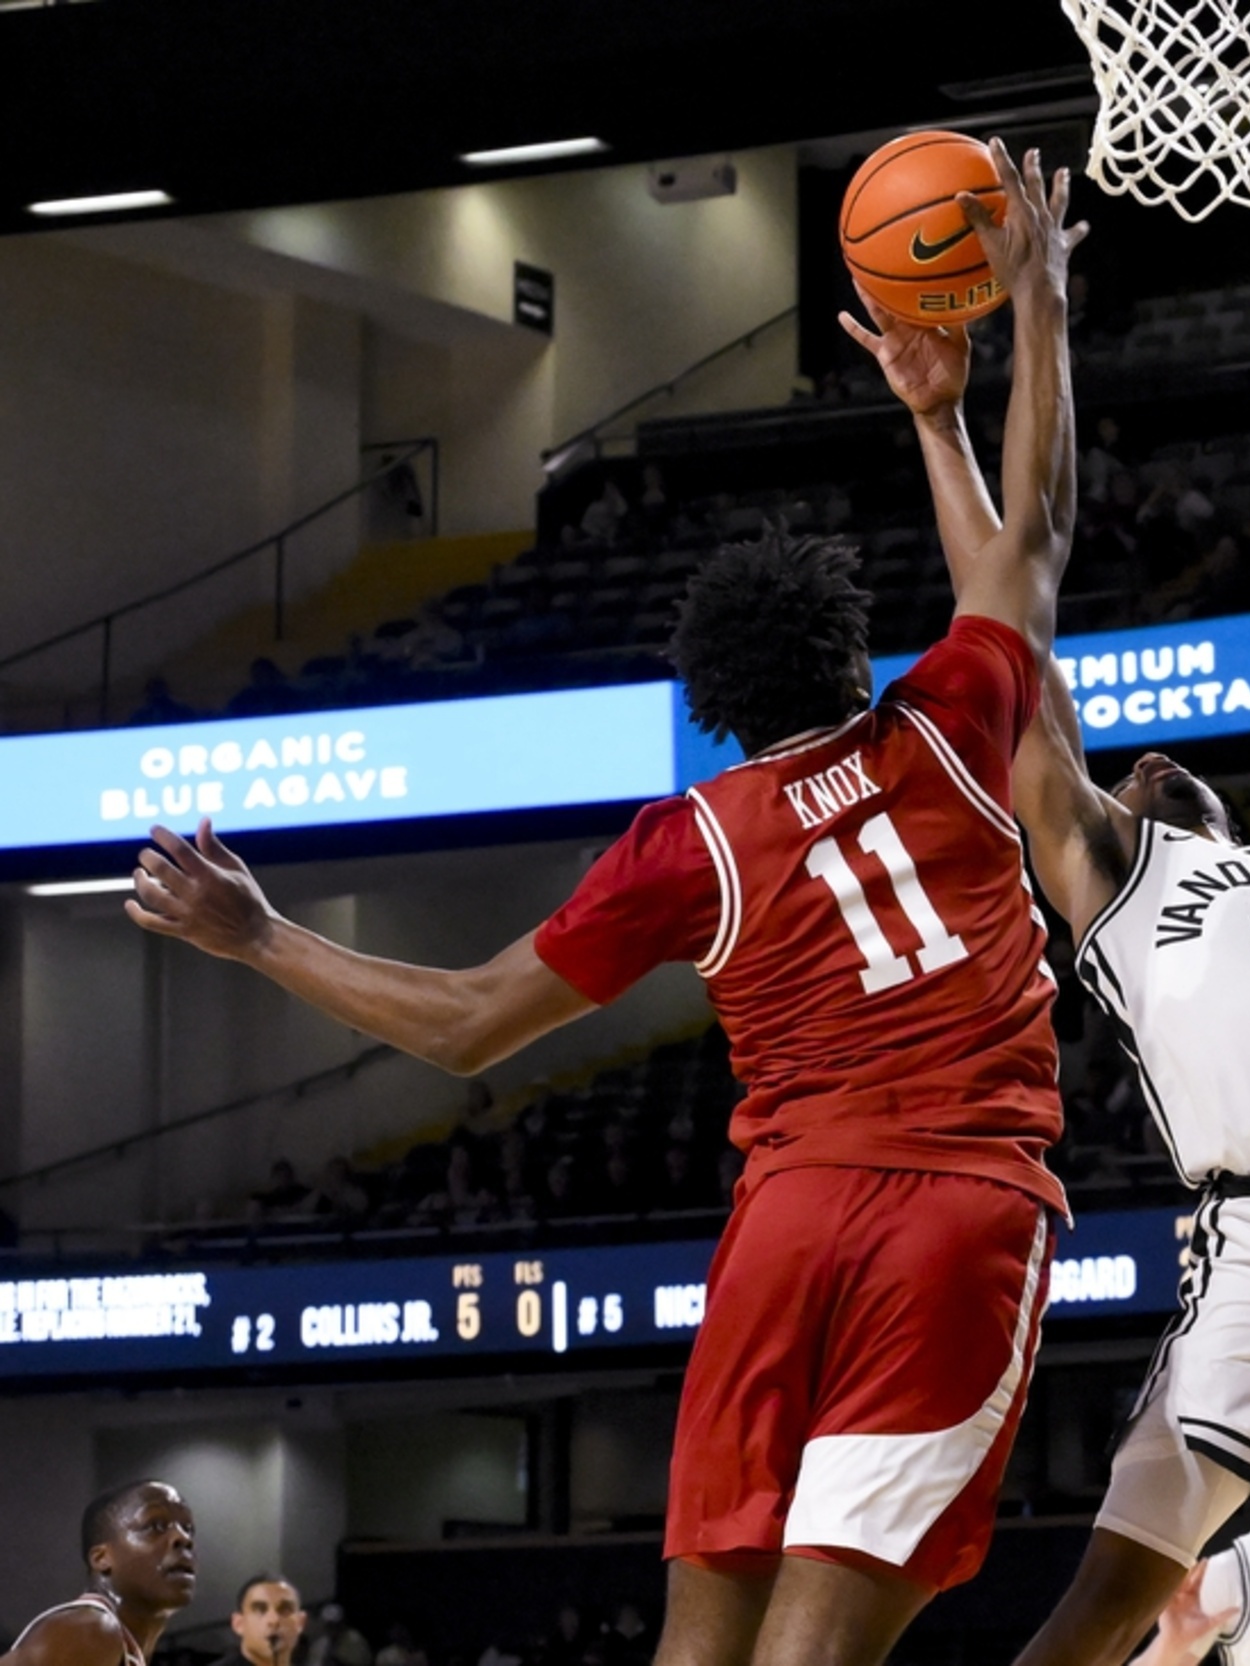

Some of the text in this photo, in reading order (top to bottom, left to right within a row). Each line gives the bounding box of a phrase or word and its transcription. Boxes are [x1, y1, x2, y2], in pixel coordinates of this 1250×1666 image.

[140, 731, 366, 779] ORGANIC
[100, 766, 408, 821] BLUE AGAVE
[784, 750, 882, 830] KNOX
[804, 812, 969, 994] 11
[453, 1261, 543, 1288] PTS FLS
[301, 1302, 400, 1348] COLLINS
[401, 1300, 438, 1342] JR.
[457, 1293, 480, 1340] 5
[517, 1290, 541, 1336] 0
